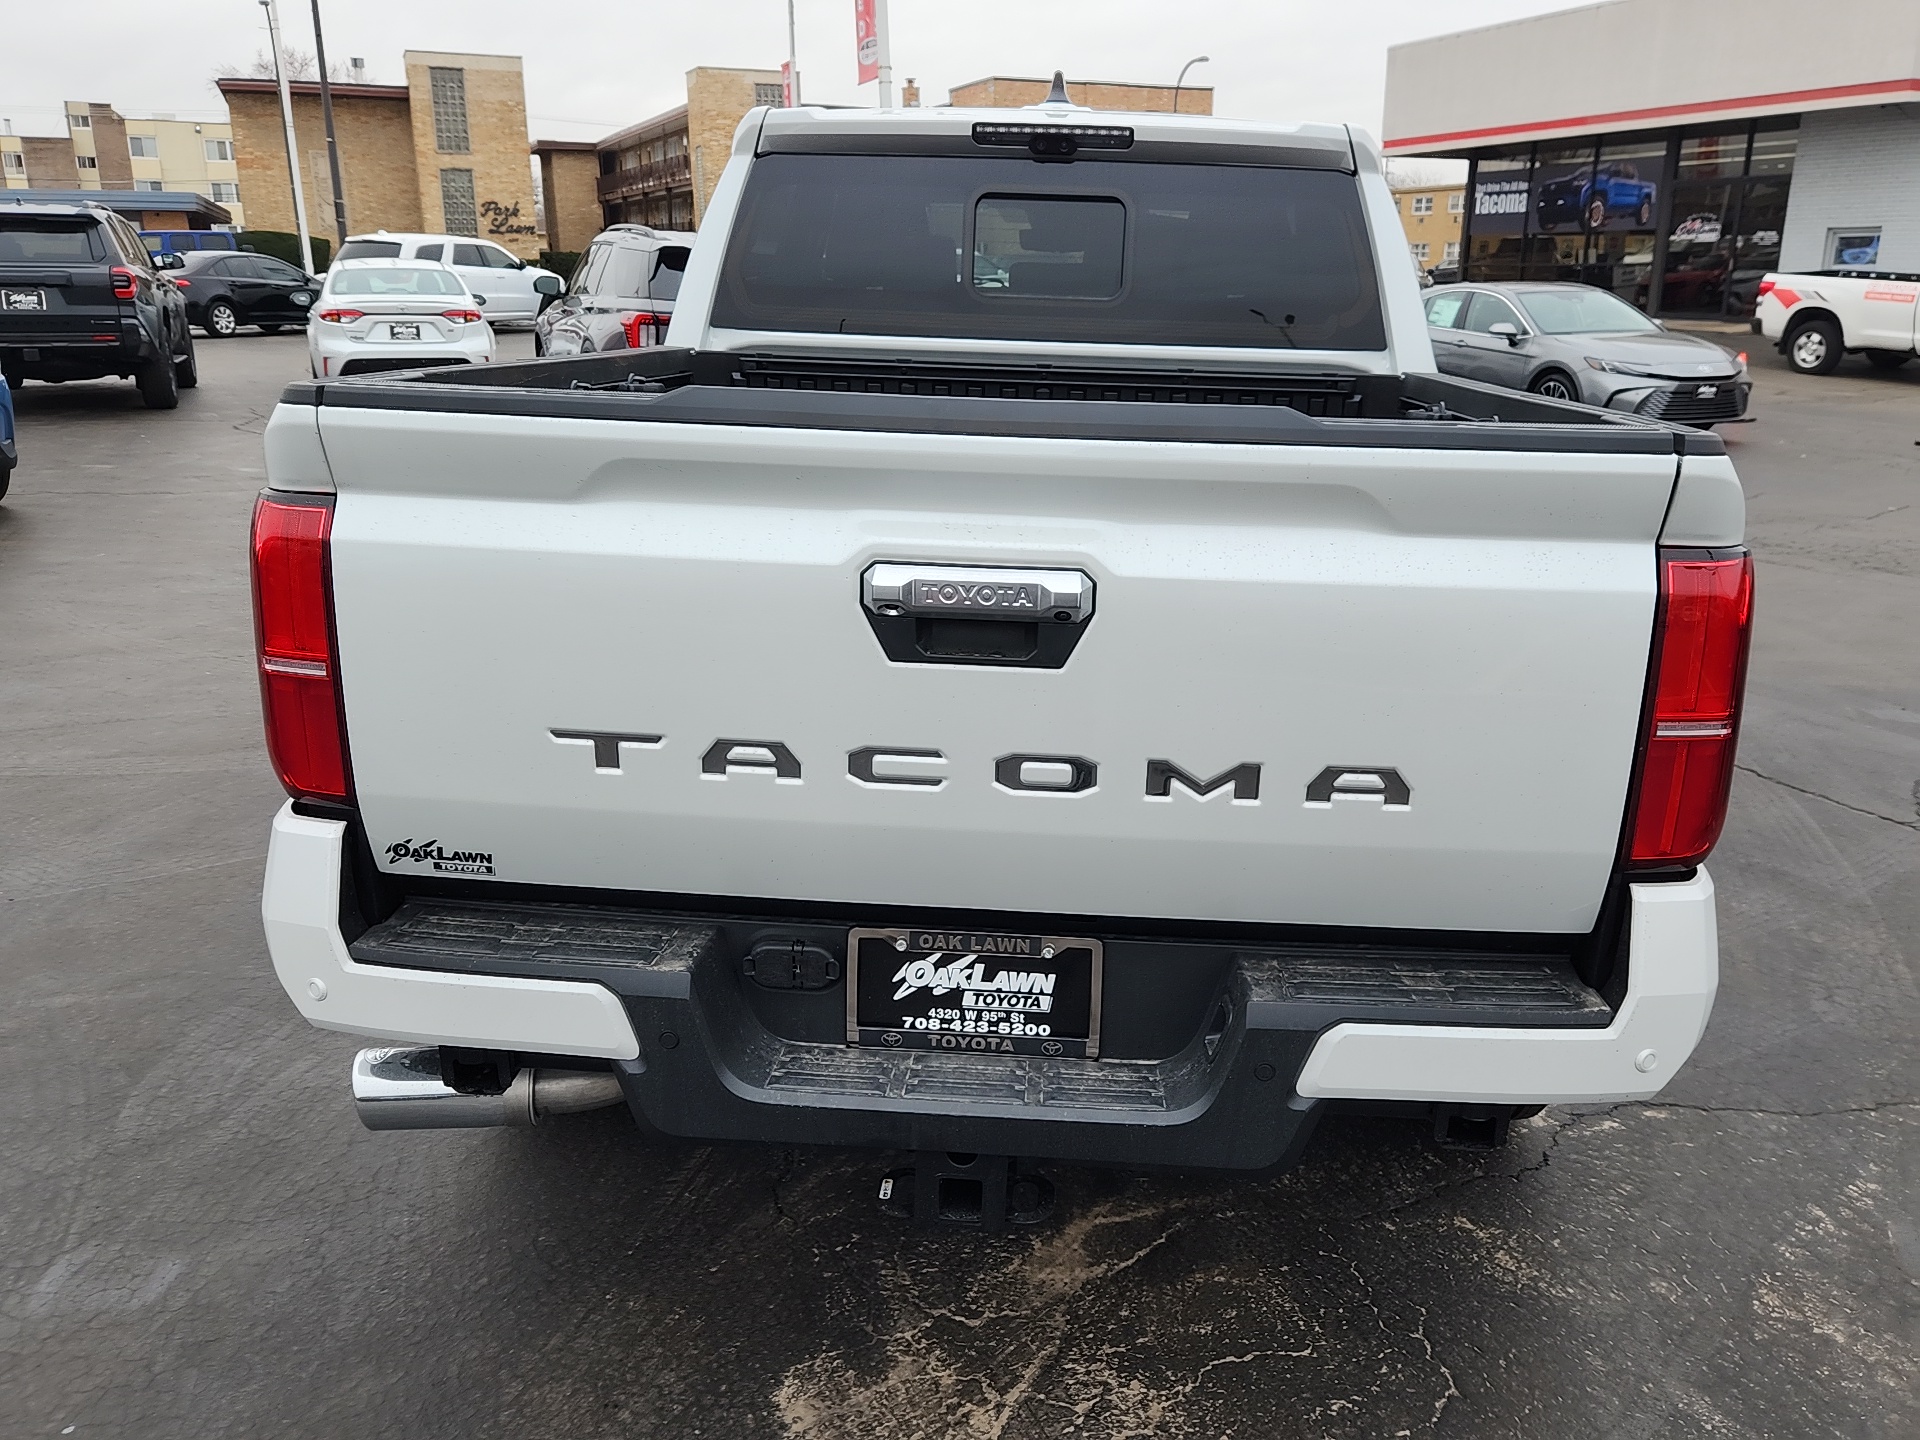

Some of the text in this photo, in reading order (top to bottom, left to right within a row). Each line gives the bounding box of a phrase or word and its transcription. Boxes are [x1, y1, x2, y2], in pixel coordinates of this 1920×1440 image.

[481, 201, 520, 217] Park
[1475, 192, 1528, 215] Tacoma
[488, 213, 536, 235] Lawn
[921, 583, 1034, 607] TOYOTA
[548, 727, 1413, 812] TACOMA
[440, 862, 488, 873] TOYOTA
[919, 933, 1030, 954] OAK LAWN
[972, 992, 1042, 1009] TOYOTA
[928, 1008, 1025, 1023] 4320 W 95th St
[902, 1016, 1051, 1037] 708-423-5200
[927, 1034, 1015, 1052] TOYOTA
